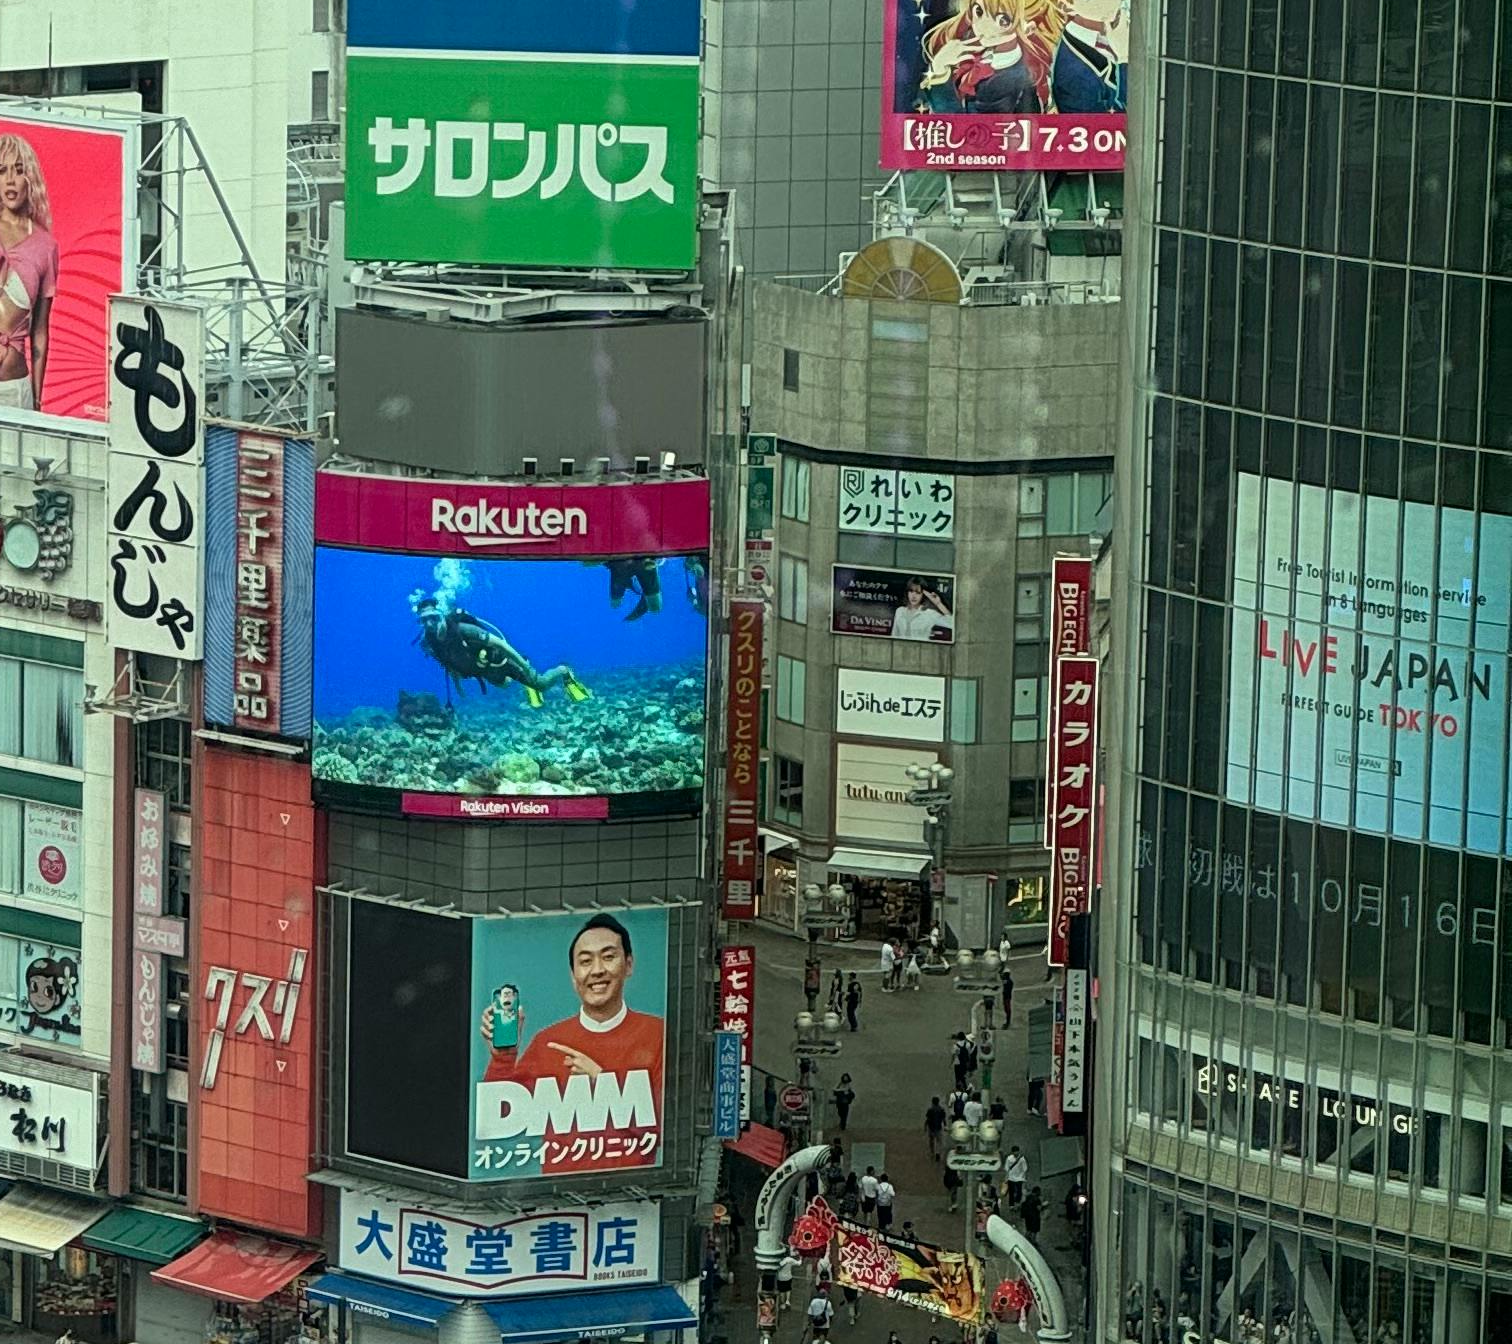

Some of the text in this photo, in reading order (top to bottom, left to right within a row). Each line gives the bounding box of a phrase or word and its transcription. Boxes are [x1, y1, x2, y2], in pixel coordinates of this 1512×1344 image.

[368, 116, 674, 205] サロンパス
[926, 152, 1006, 166] 2nd season
[113, 305, 199, 649] もんじゃ
[871, 473, 954, 506] れいわ
[431, 498, 588, 538] Rakuten
[842, 500, 953, 533] クリニック
[234, 447, 272, 721] 三千里薬品
[1059, 583, 1079, 616] BIG
[1260, 620, 1492, 702] LIVE JAPAN
[727, 610, 758, 906] クスリのことなら 三千里
[1059, 680, 1092, 829] カラオケ
[460, 799, 549, 815] Rakuten Vision
[1061, 847, 1081, 882] BIG
[200, 947, 309, 1092] クスリ
[475, 1069, 657, 1141] DMM
[474, 1132, 658, 1170] オンラインクリニック
[355, 1209, 639, 1277] 大盛堂書店
[593, 1268, 648, 1281] BOOKS TAISEIDO
[349, 1302, 390, 1319] TAISEIDO
[578, 1327, 626, 1339] TAISEIDO
